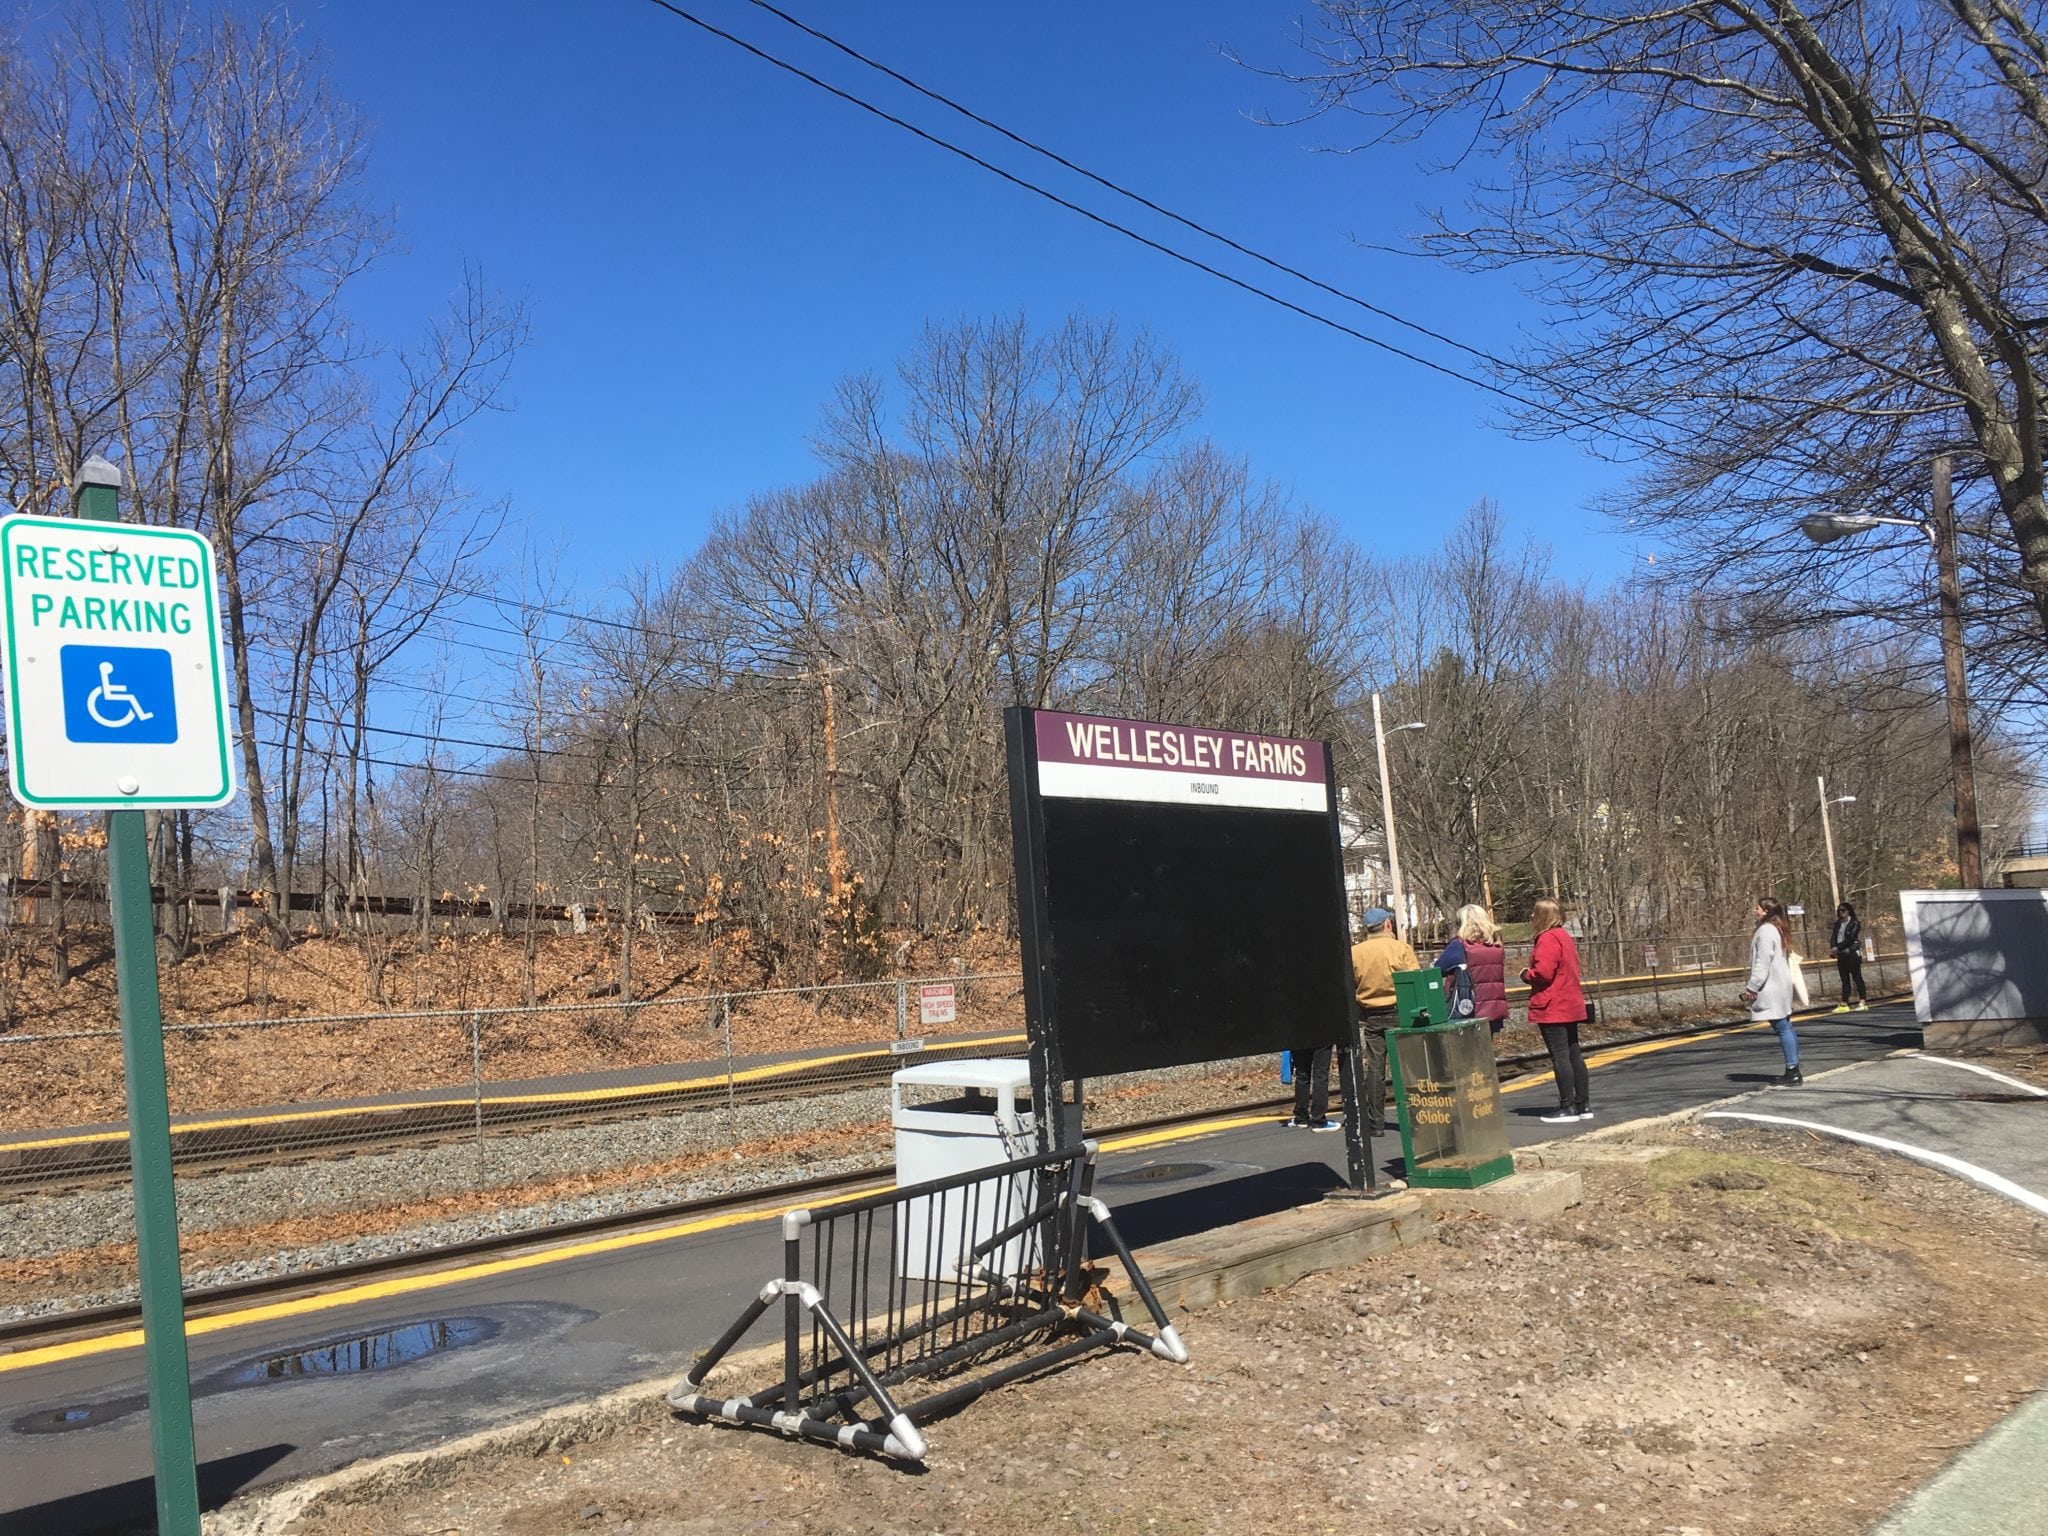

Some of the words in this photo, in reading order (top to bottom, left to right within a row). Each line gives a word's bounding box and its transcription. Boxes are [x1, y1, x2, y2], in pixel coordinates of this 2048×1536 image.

[16, 544, 199, 589] RESERVED
[31, 593, 191, 635] PARKING
[1065, 721, 1223, 769] WELLESLEY
[1231, 739, 1306, 776] FARMS
[1190, 782, 1219, 794] INBOUND
[936, 1000, 953, 1008] SPEED
[896, 1041, 919, 1050] INBOUND
[1417, 1078, 1440, 1093] The
[1408, 1093, 1453, 1107] Boston
[1416, 1109, 1451, 1124] Globe
[1472, 1102, 1493, 1119] Globe
